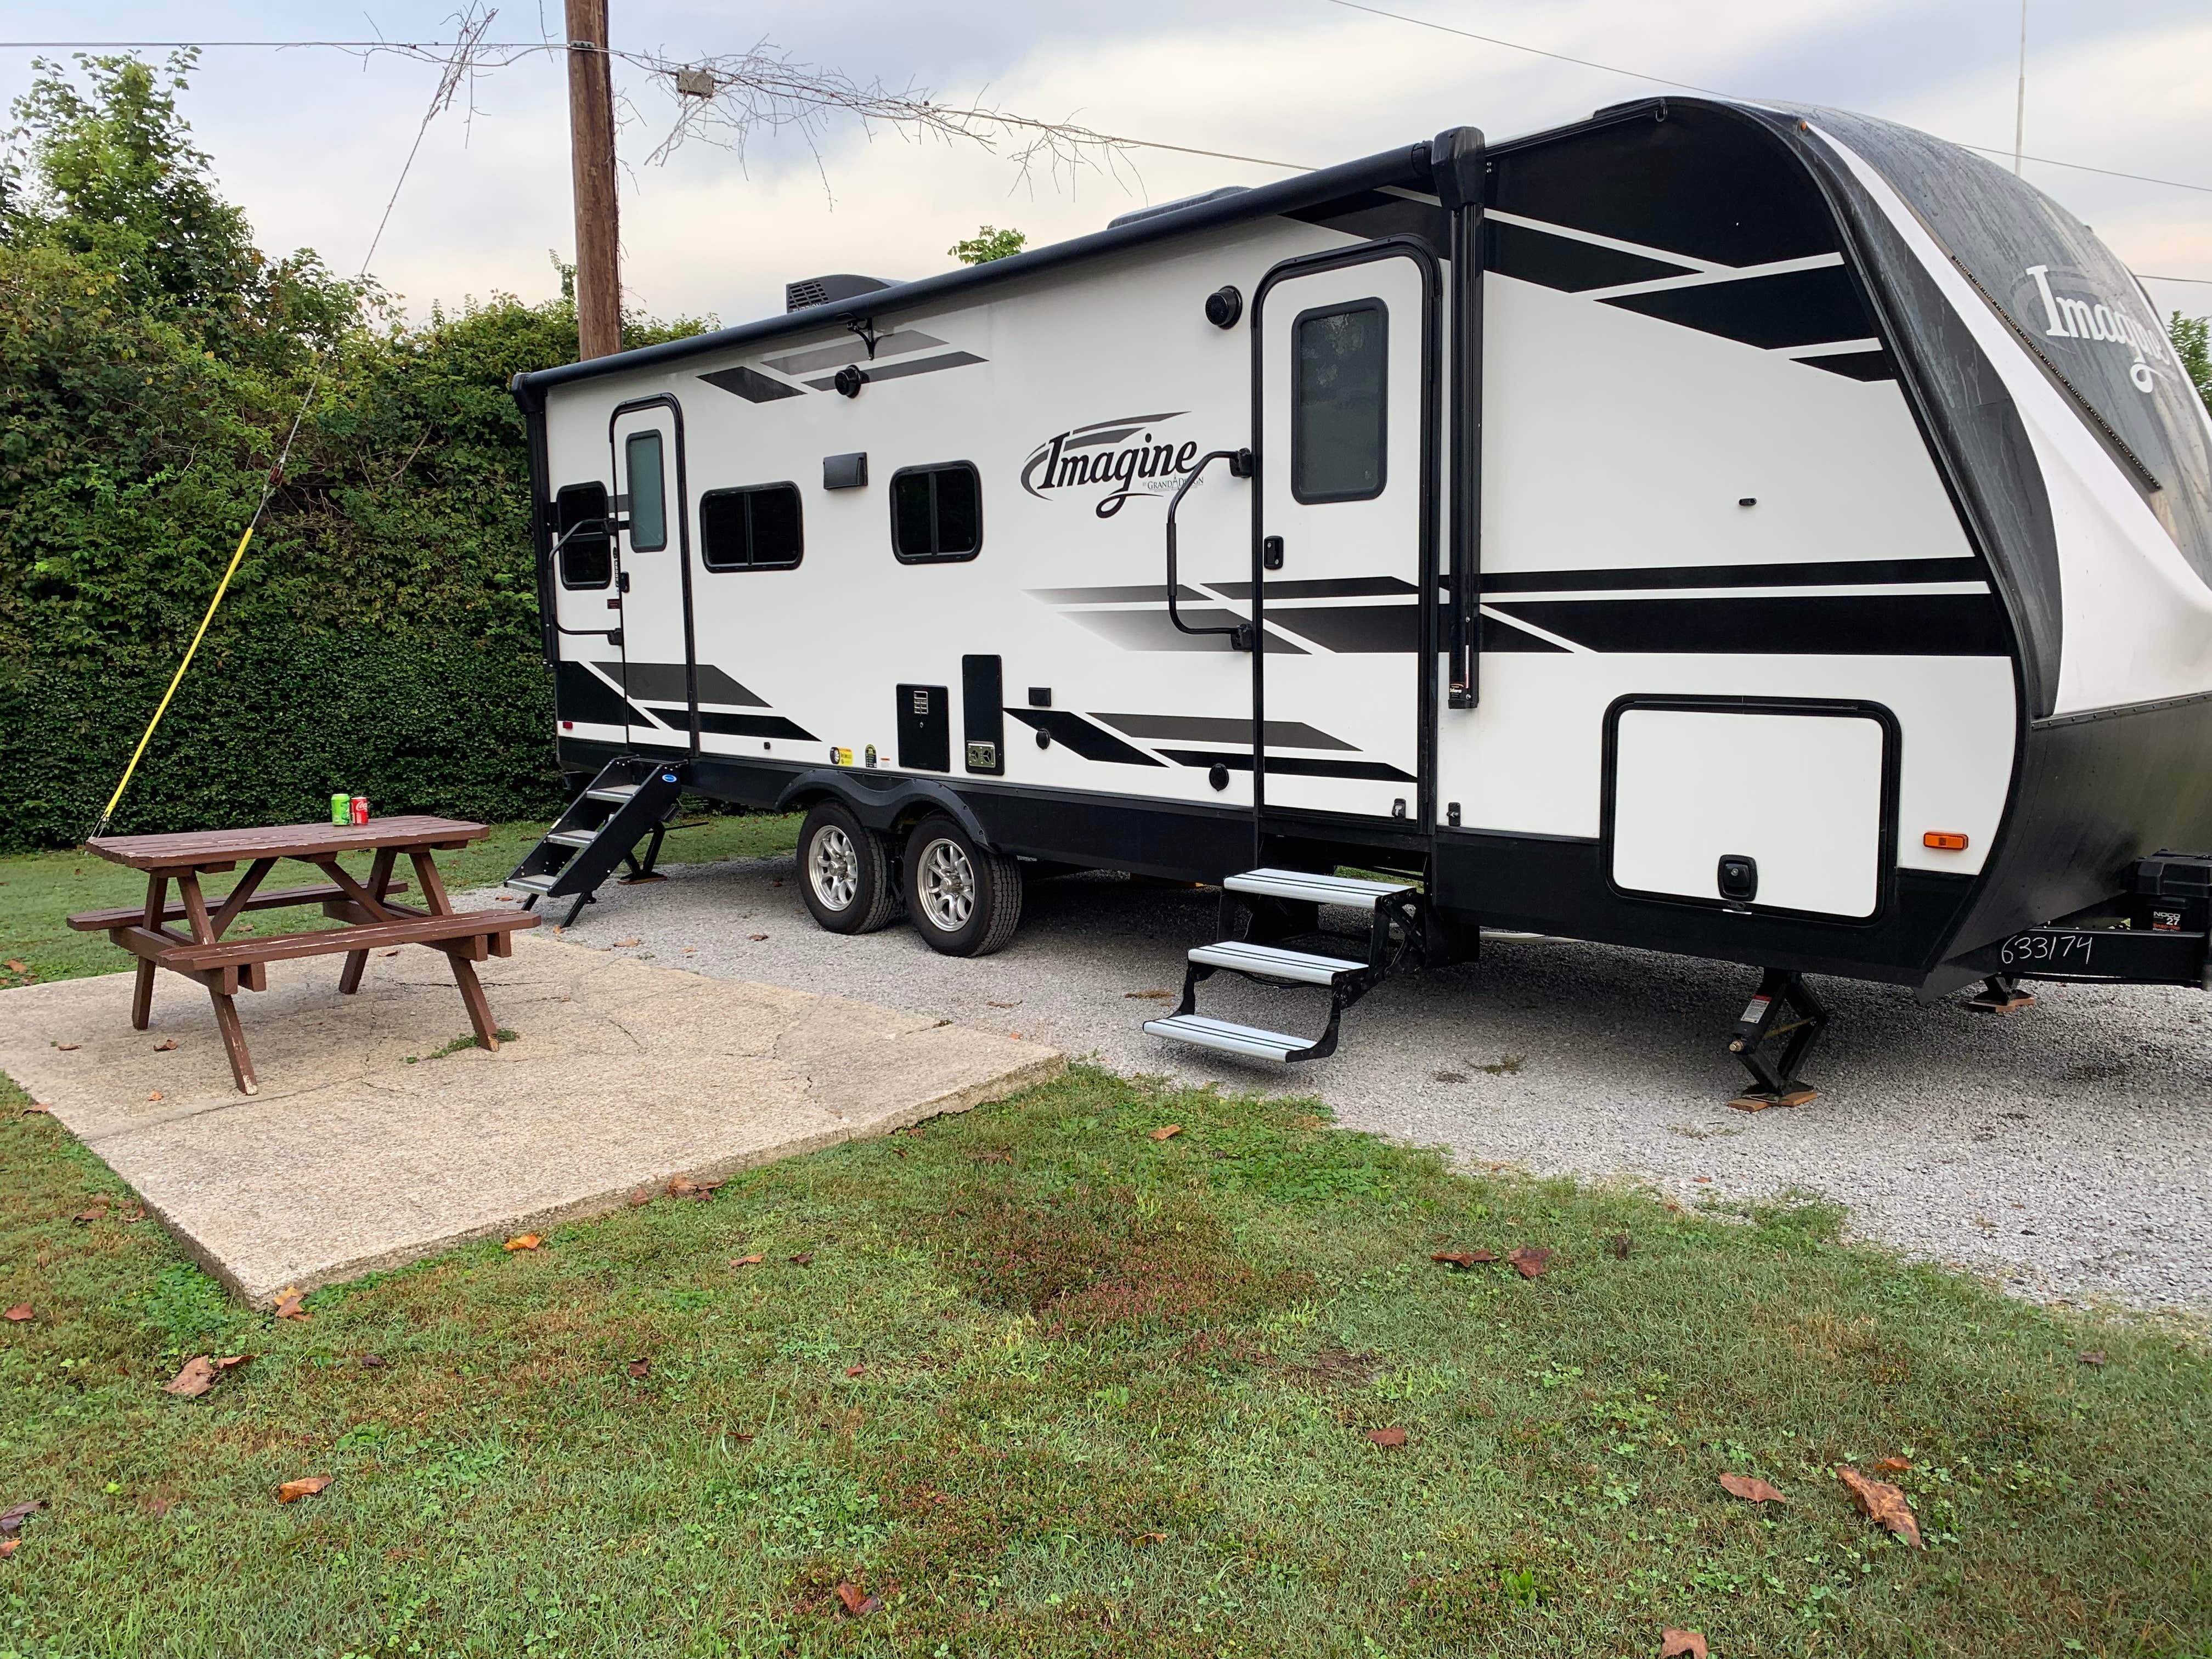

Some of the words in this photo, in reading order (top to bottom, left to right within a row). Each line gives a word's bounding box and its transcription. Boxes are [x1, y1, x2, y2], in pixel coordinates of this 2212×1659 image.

[1037, 431, 1198, 519] Imagine
[1147, 480, 1172, 490] GRAND
[2166, 917, 2180, 926] 27
[2001, 935, 2093, 965] 633174
